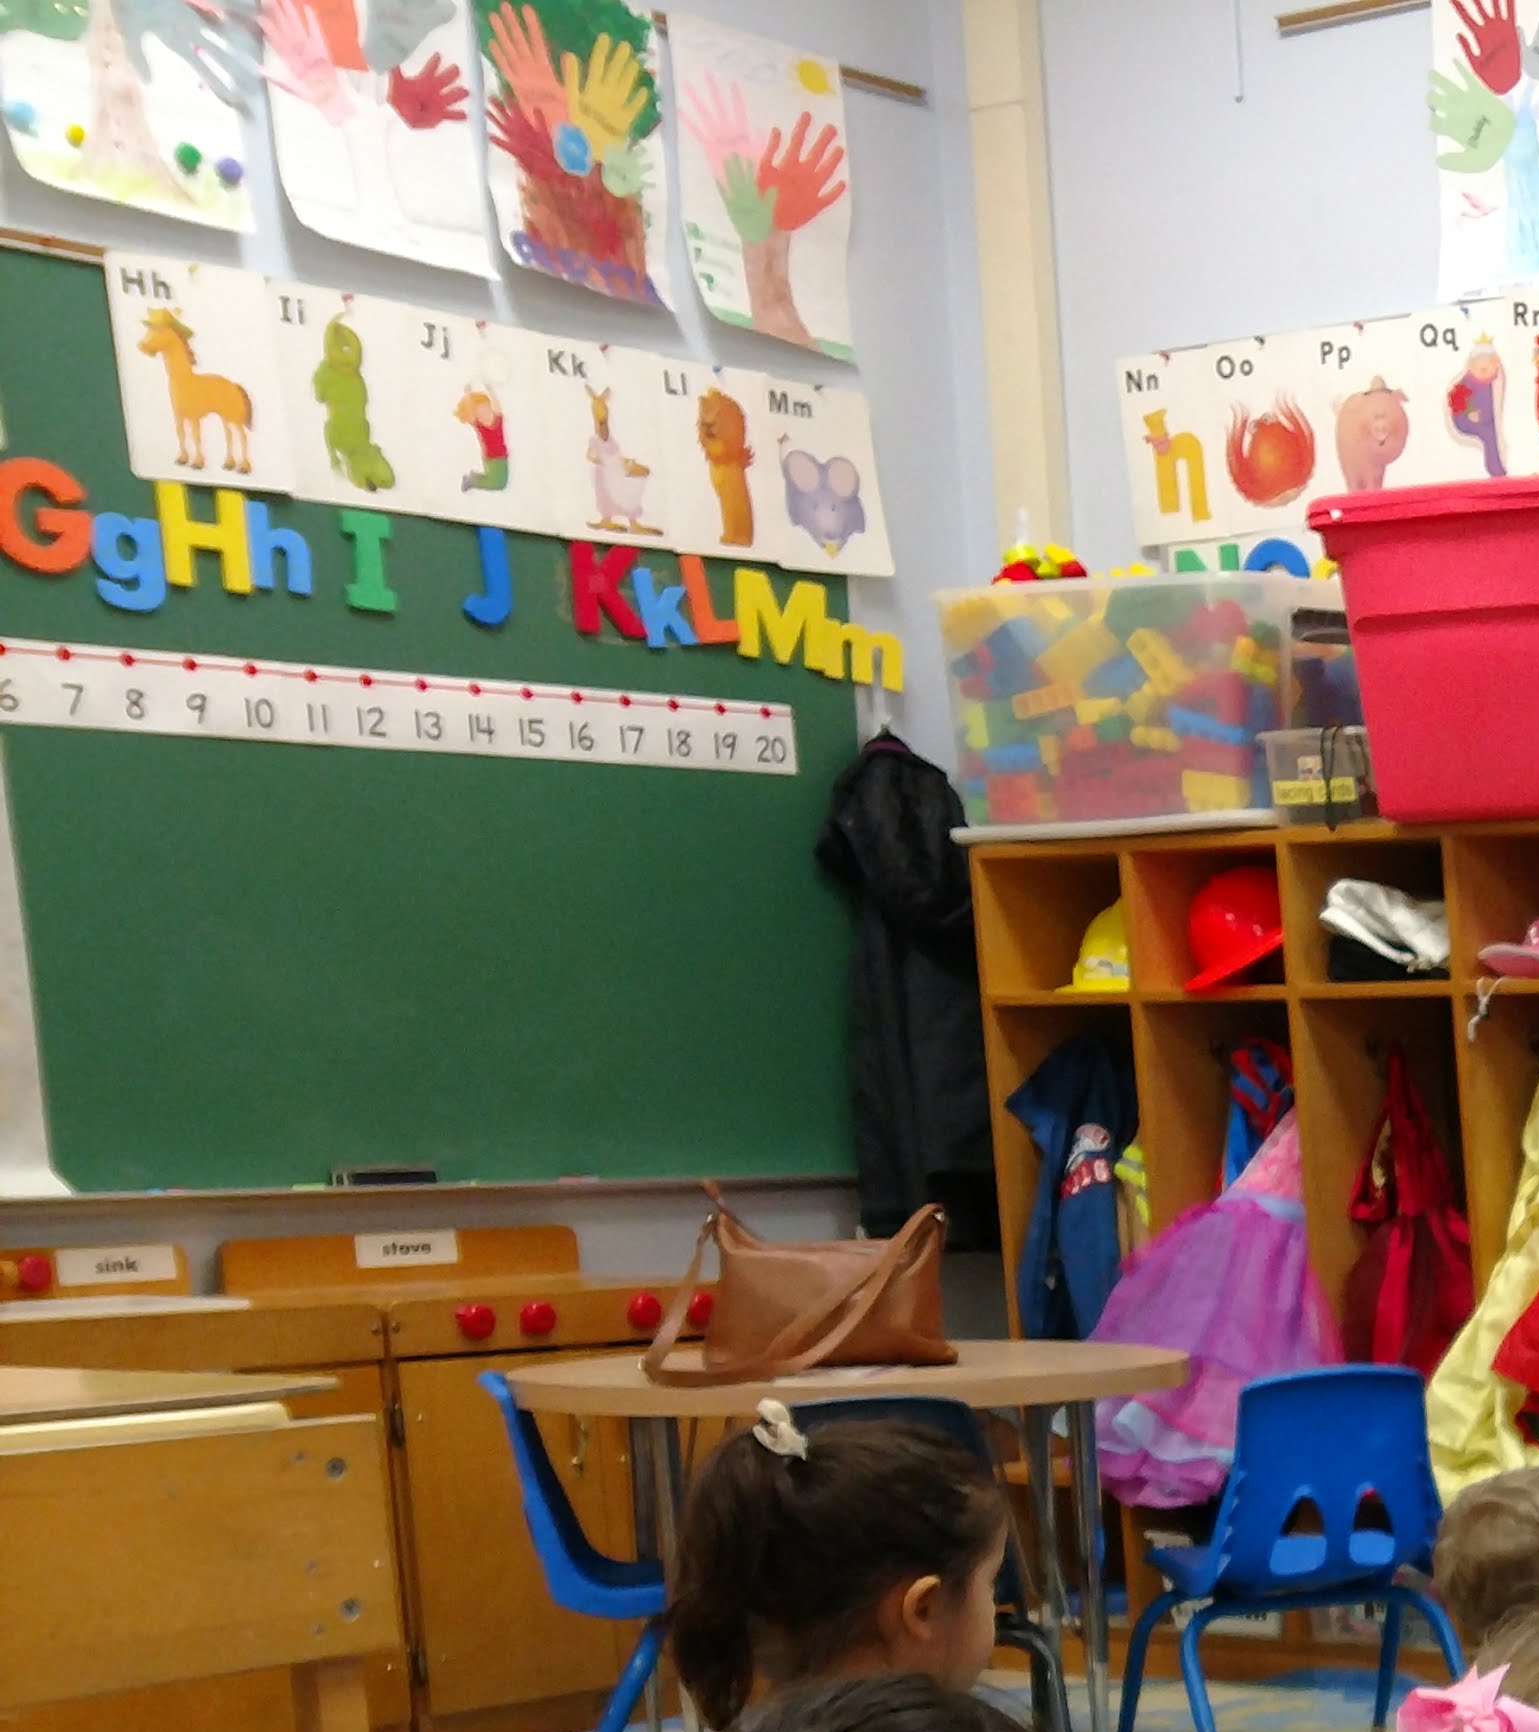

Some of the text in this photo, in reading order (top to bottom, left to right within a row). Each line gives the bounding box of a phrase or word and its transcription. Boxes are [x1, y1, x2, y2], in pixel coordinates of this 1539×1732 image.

[121, 266, 172, 301] Hh
[279, 295, 307, 326] Ii
[420, 323, 451, 360] Jj
[548, 349, 586, 381] Kk
[768, 389, 814, 420] Mm
[1125, 370, 1159, 394] Nn
[1217, 356, 1253, 380] Oo
[1321, 341, 1352, 371] Pp
[1420, 325, 1461, 353] Qq
[340, 511, 397, 613] I
[462, 527, 512, 625] J
[61, 684, 85, 717] 7
[125, 689, 147, 720] 8
[186, 694, 208, 725] 9
[244, 698, 274, 730] 10
[308, 703, 329, 734] 11
[357, 706, 387, 738] 12
[414, 710, 443, 741] 13
[469, 713, 495, 744] 14
[518, 718, 545, 749] 15
[568, 722, 595, 752] 16
[619, 726, 645, 756] 17
[667, 729, 693, 759] 18
[714, 732, 738, 761] 19
[756, 734, 787, 765] 20
[94, 1259, 140, 1276] sink
[381, 1240, 433, 1258] stove
